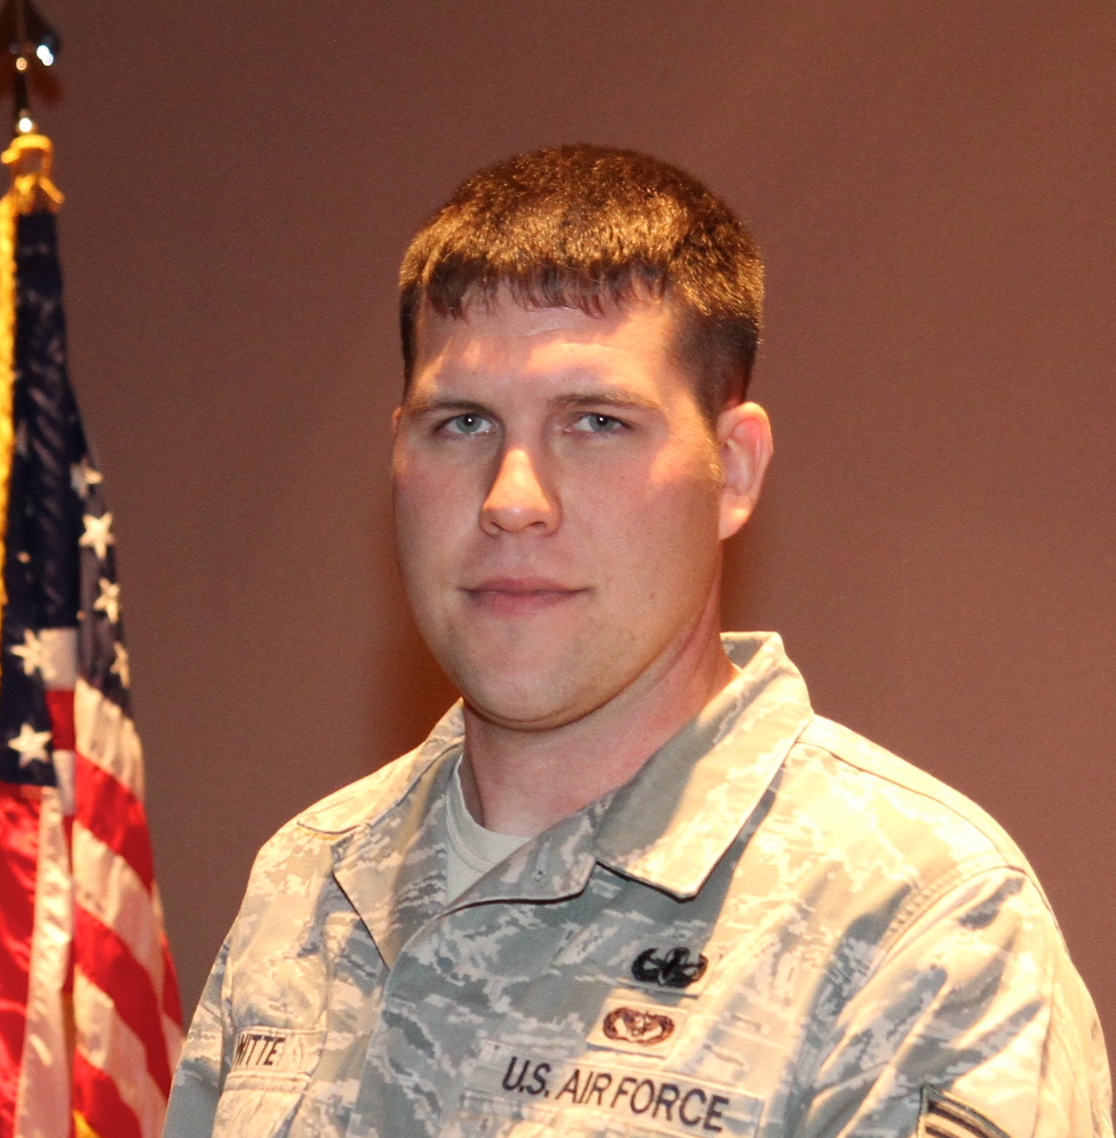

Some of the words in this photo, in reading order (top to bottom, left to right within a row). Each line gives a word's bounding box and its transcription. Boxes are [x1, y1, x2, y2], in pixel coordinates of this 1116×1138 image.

[501, 1056, 551, 1098] U.S.
[555, 1068, 613, 1106] AIR
[610, 1075, 730, 1133] FORCE
